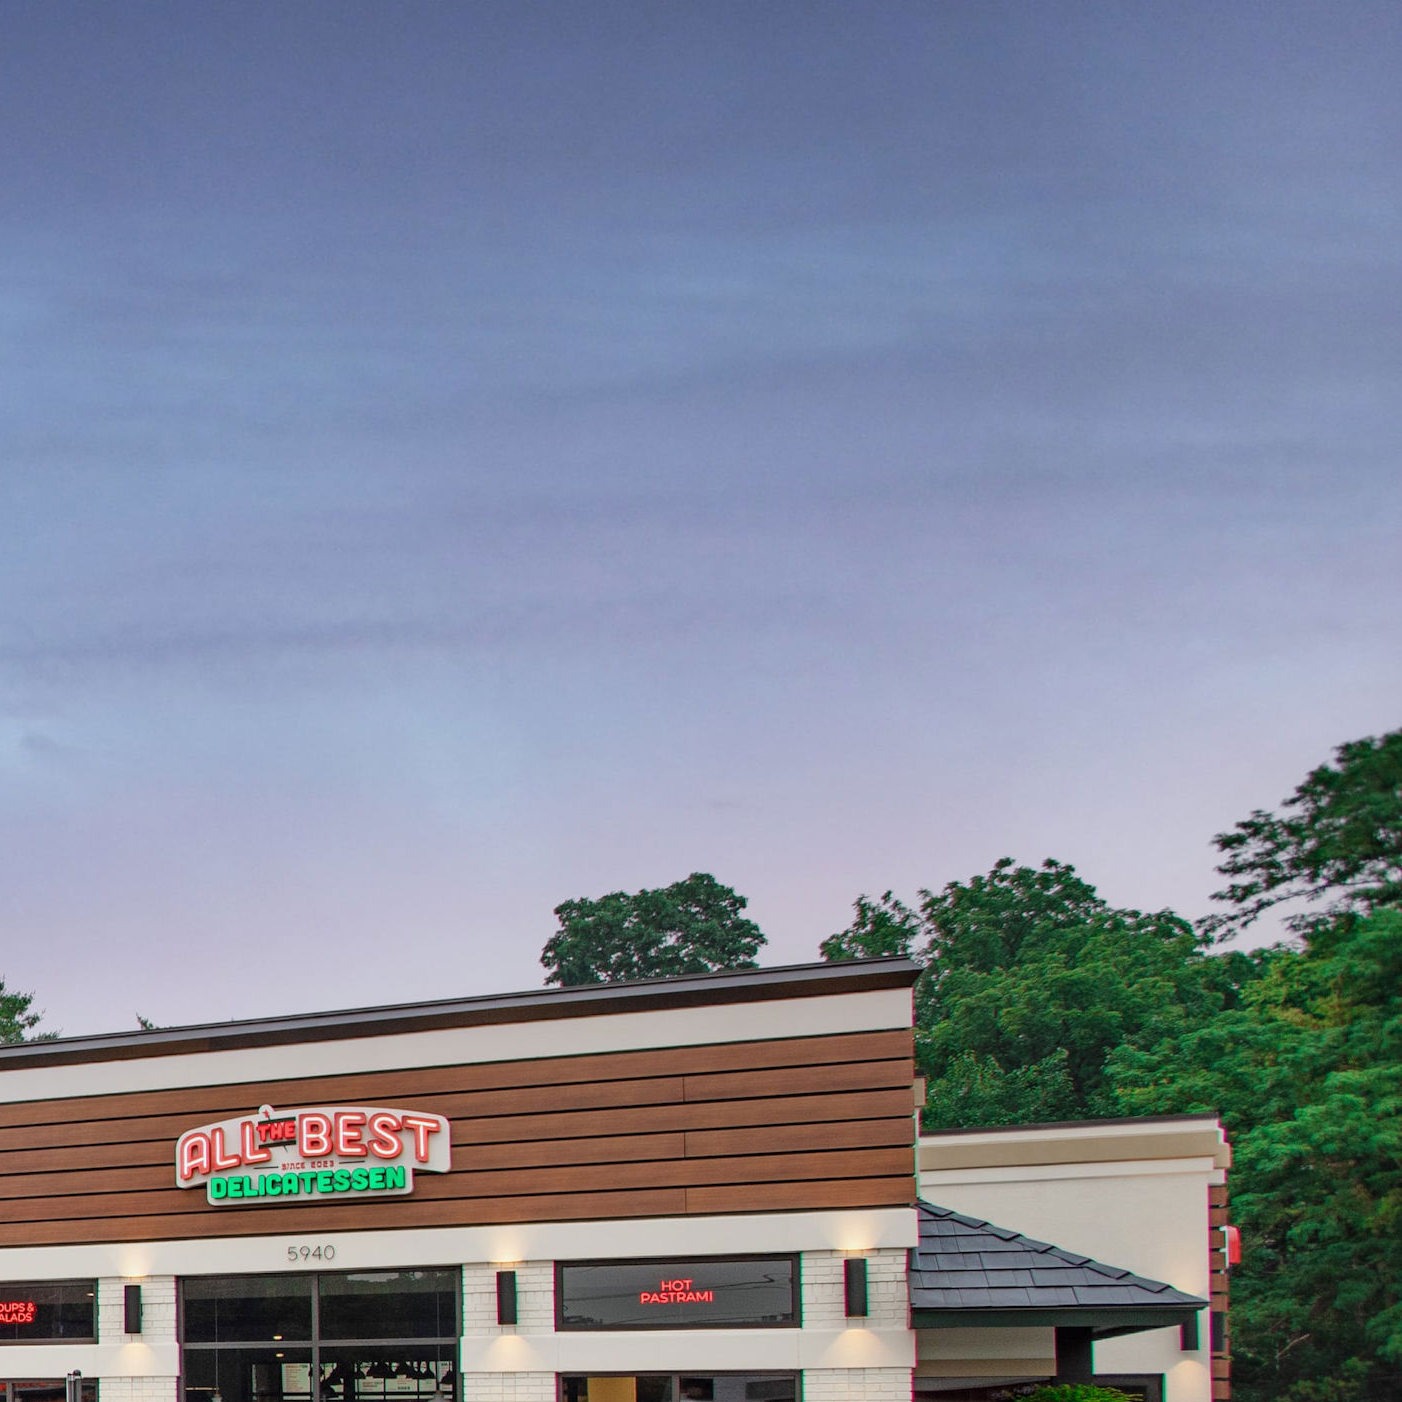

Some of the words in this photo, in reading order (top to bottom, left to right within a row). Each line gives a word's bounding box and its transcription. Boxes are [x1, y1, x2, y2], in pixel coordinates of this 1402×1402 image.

[179, 1121, 271, 1180] ALL
[256, 1121, 296, 1143] THE
[298, 1112, 441, 1162] BEST
[281, 1161, 306, 1171] SINCE
[310, 1160, 335, 1169] 2023
[211, 1166, 406, 1199] DELICATESSEN
[287, 1244, 335, 1261] 5940
[661, 1279, 693, 1292] HOT
[639, 1291, 714, 1304] PASTRAMI
[27, 1302, 35, 1312] &
